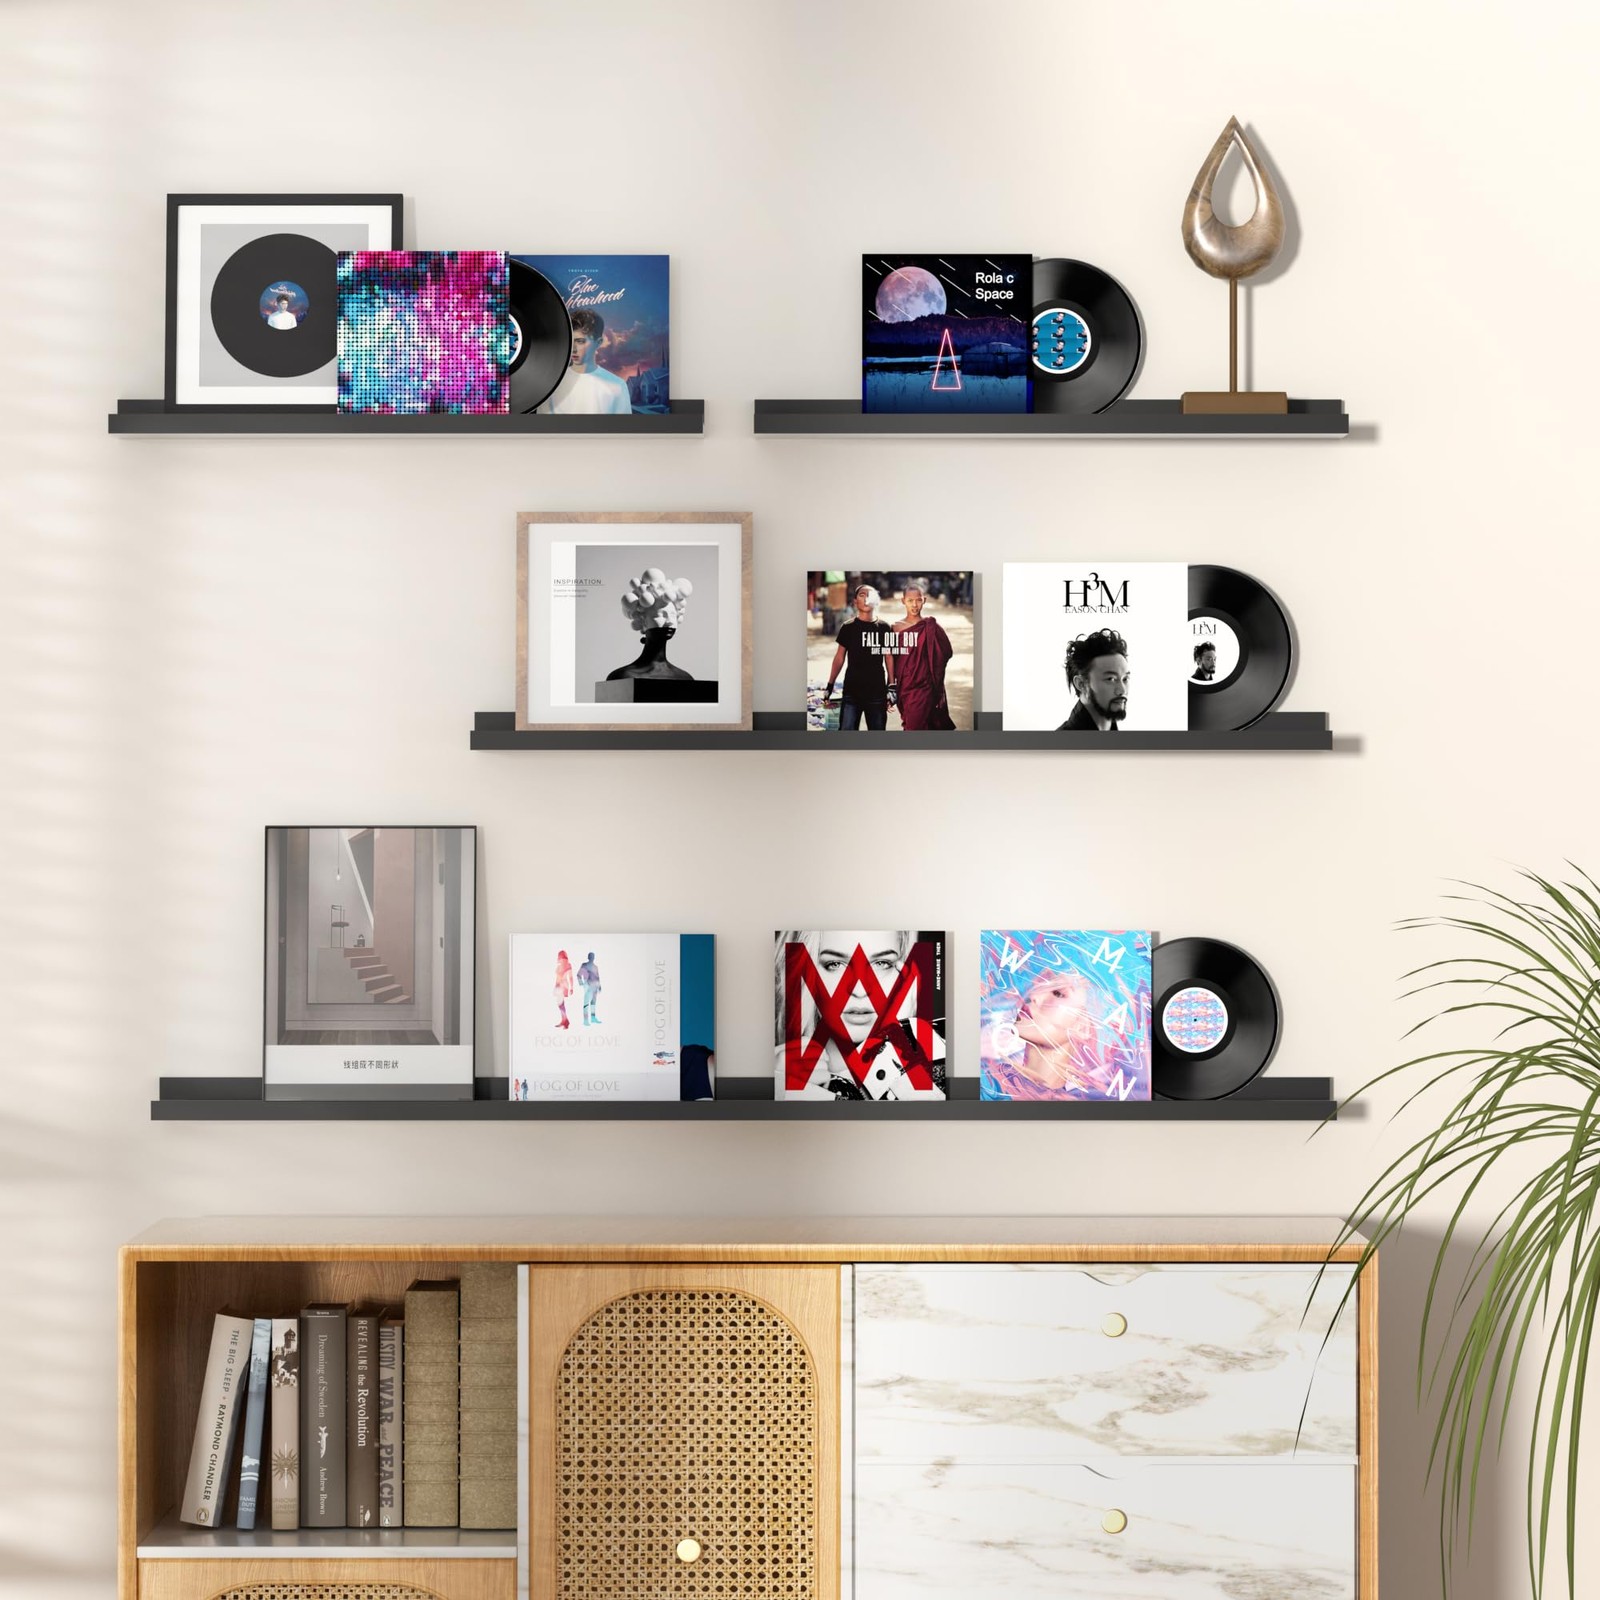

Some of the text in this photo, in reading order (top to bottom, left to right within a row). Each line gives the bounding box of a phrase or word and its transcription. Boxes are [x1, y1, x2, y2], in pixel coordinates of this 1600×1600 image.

[568, 275, 599, 296] Blue
[975, 272, 1014, 284] Rola c
[975, 287, 1014, 302] Space
[1064, 605, 1128, 614] EASON CHAN
[861, 631, 919, 647] FALL OUT BOY
[654, 960, 666, 1046] FOG OF LOVE
[534, 1035, 563, 1048] FOG
[587, 1035, 622, 1048] LOVE
[533, 1080, 621, 1092] FOG OF LOVE
[316, 1334, 328, 1374] Dreaming
[358, 1319, 370, 1447] REVEALING the Revolution
[318, 1386, 328, 1418] Sweden
[379, 1377, 394, 1425] WAR
[202, 1329, 240, 1501] THE BIG SLEEP RAYMOND CHANDLER
[379, 1444, 394, 1508] PEACE
